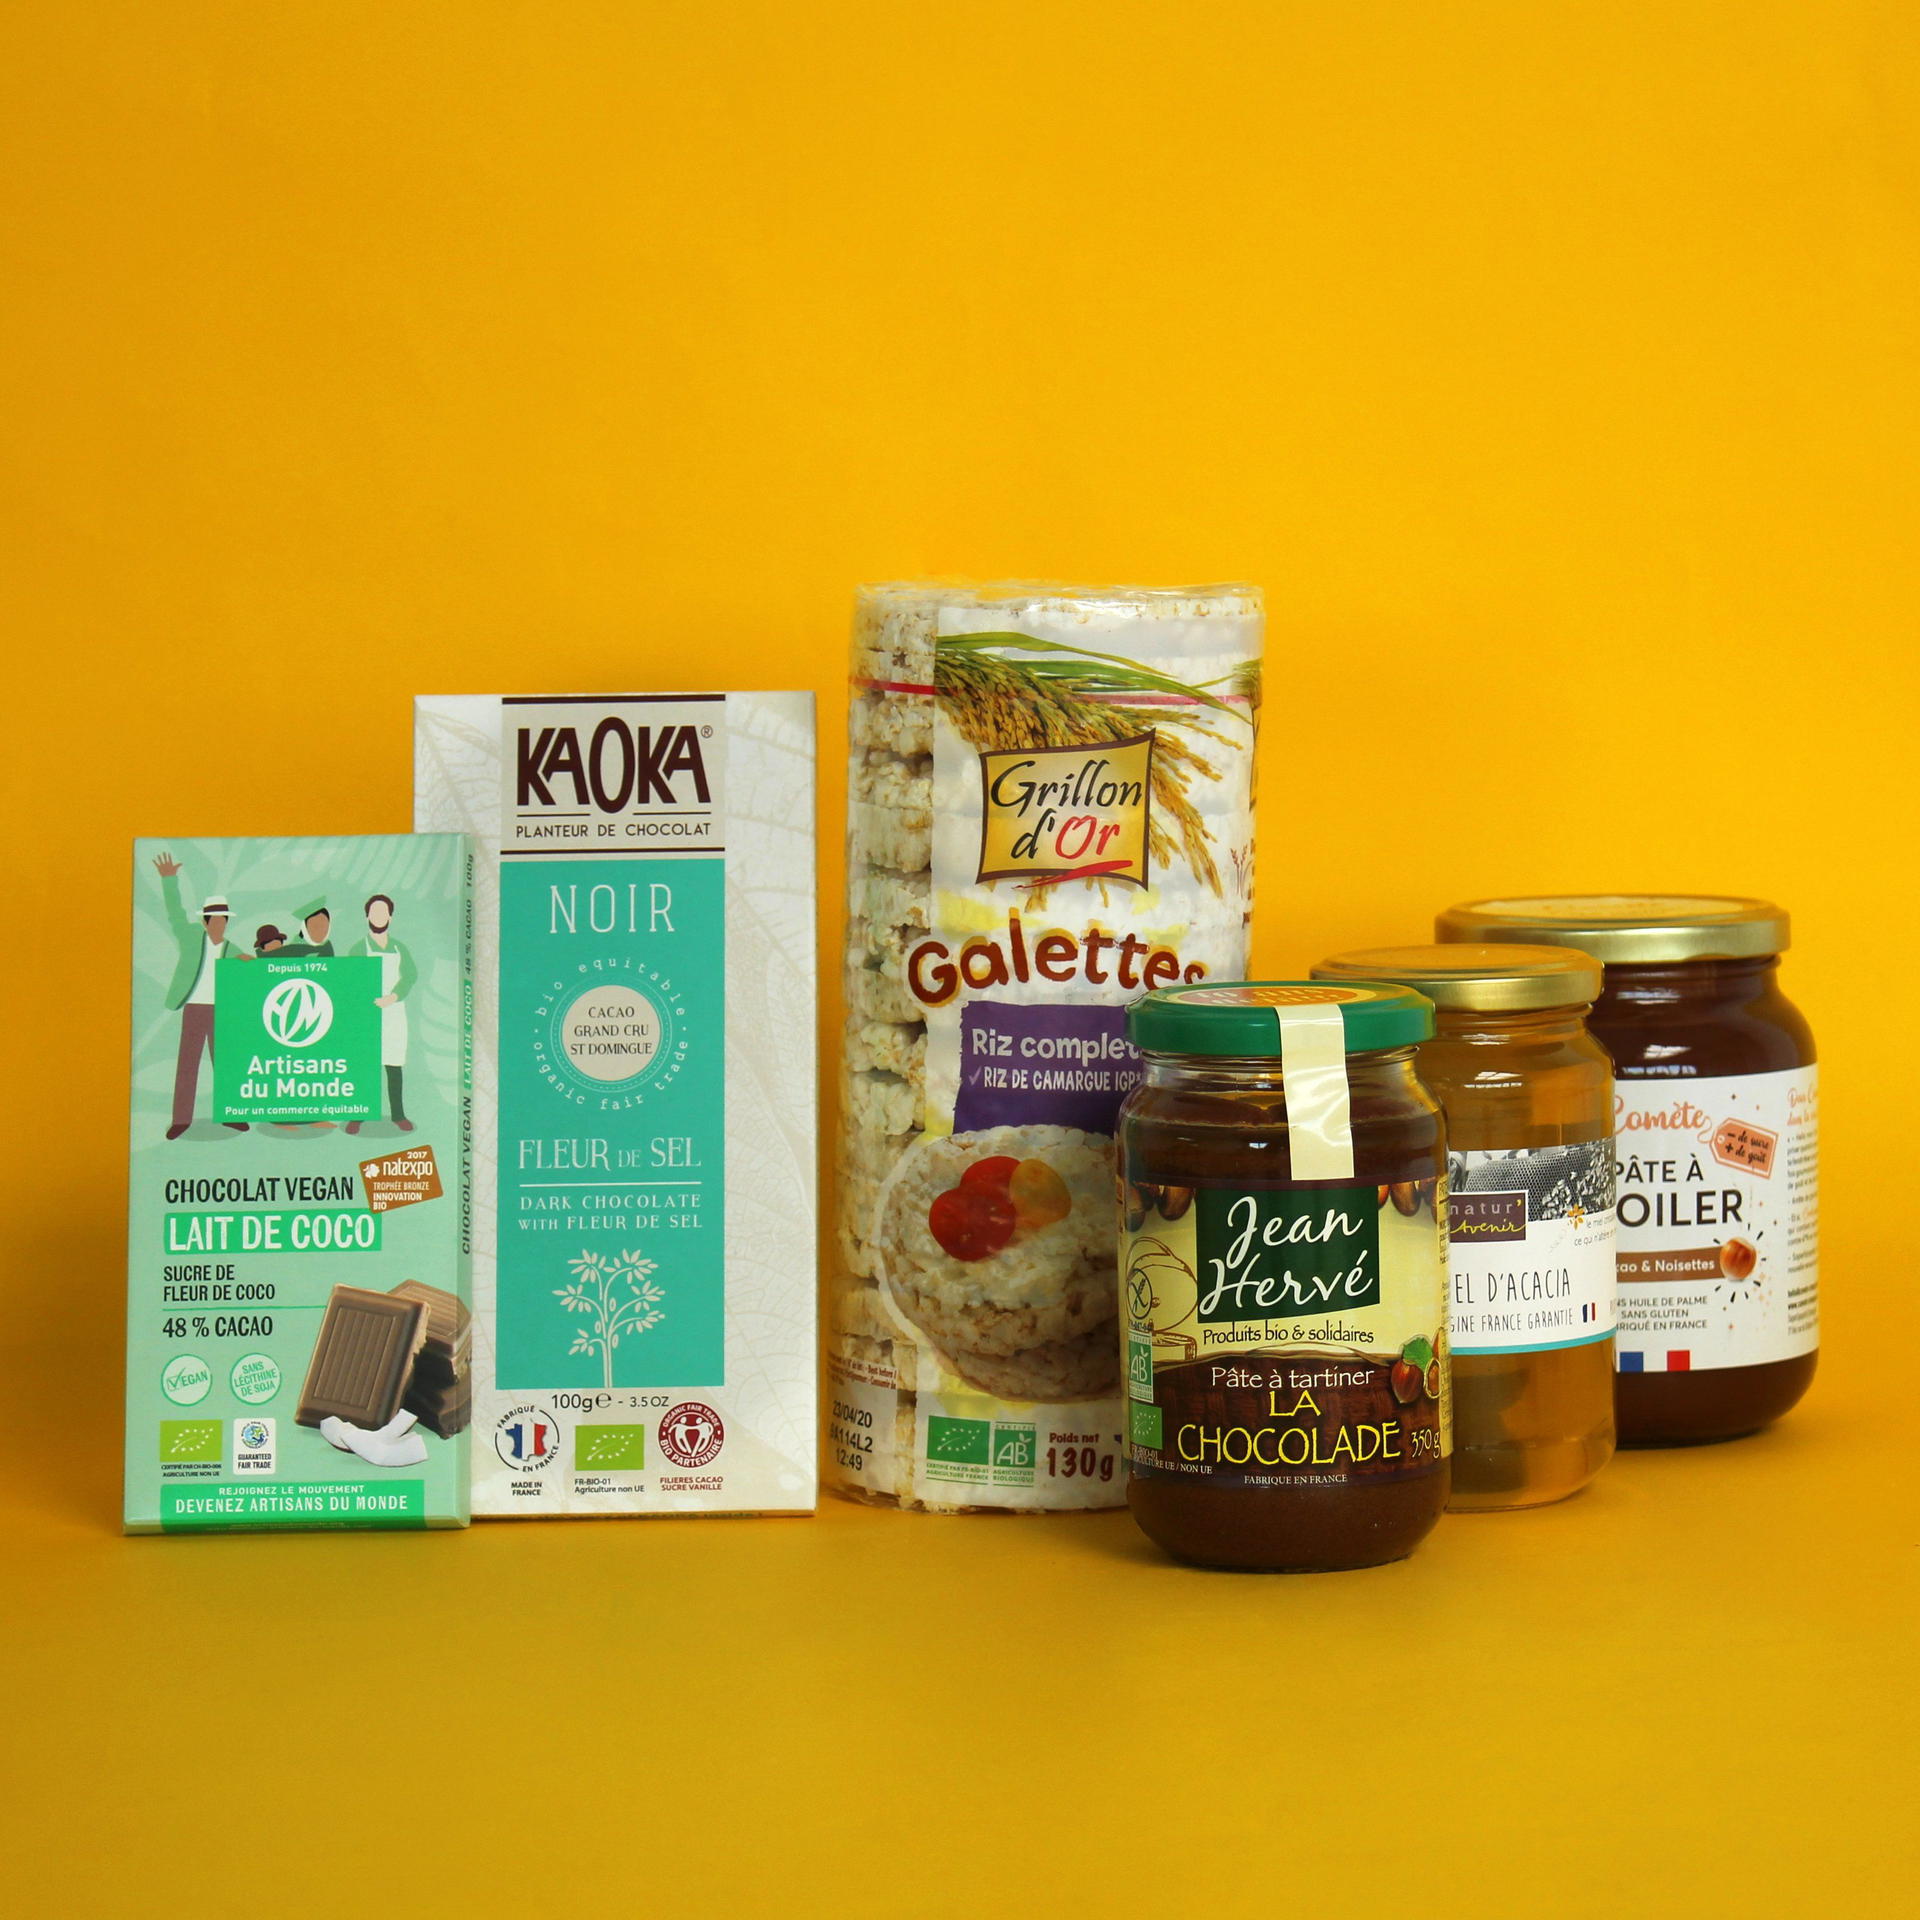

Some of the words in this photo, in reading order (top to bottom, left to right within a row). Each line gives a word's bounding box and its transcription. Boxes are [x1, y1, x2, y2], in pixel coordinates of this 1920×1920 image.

[517, 717, 711, 814] KAOKA
[990, 760, 1143, 817] Grillon
[516, 824, 588, 838] PLANTEUR
[598, 824, 616, 837] DE
[625, 822, 711, 836] CHOCOLAT
[1012, 811, 1120, 860] d'Or
[466, 854, 474, 887] 100g
[550, 884, 675, 934] NOIR
[908, 910, 1206, 1003] Galettes
[268, 964, 301, 974] Depuis
[305, 963, 328, 972] 1974
[536, 982, 562, 1016] bio
[578, 958, 685, 1016] equitable
[588, 1006, 634, 1018] CACAO
[574, 1025, 619, 1037] GRAND
[624, 1025, 648, 1037] CRU
[570, 1044, 585, 1055] ST
[588, 1042, 652, 1055] DOMINGUE
[972, 1029, 1012, 1058] Riz
[248, 1056, 348, 1076] Artisans
[534, 1042, 586, 1104] organic
[600, 1094, 643, 1110] fair
[654, 1041, 688, 1090] trade
[240, 1080, 268, 1099] du
[276, 1077, 355, 1098] Monde
[984, 1067, 1007, 1088] RIZ
[1012, 1068, 1028, 1088] DE
[1032, 1070, 1110, 1091] CAMARGUE
[225, 1106, 248, 1116] Pour
[267, 1106, 319, 1115] commerce
[322, 1104, 369, 1116] équitable
[463, 1096, 472, 1154] VEGAN
[1738, 1130, 1748, 1143] de
[1750, 1138, 1768, 1149] sucre
[518, 1138, 612, 1171] FLEUR
[618, 1150, 640, 1167] DE
[650, 1137, 701, 1167] SEL
[1736, 1145, 1745, 1157] de
[383, 1158, 432, 1179] natexpo
[1686, 1153, 1704, 1181] À
[166, 1178, 280, 1204] CHOCOLAT
[284, 1176, 354, 1201] VEGAN
[373, 1181, 401, 1190] TROPHÉE
[404, 1182, 430, 1190] BRONZE
[373, 1192, 422, 1200] INNOVATION
[373, 1202, 387, 1210] BIO
[462, 1158, 472, 1254] CHOCOLAT
[520, 1197, 572, 1210] DARK
[582, 1194, 701, 1209] CHOCOLATE
[1616, 1189, 1742, 1227] OILER
[169, 1216, 234, 1250] LAIT
[242, 1216, 282, 1249] DE
[291, 1214, 375, 1248] COCO
[518, 1218, 558, 1231] WITH
[567, 1217, 627, 1230] FLEUR
[636, 1216, 660, 1228] DE
[670, 1215, 702, 1228] SEL
[1226, 1196, 1363, 1269] Jean
[164, 1266, 212, 1282] SUCRE
[216, 1264, 235, 1281] DE
[1641, 1260, 1650, 1272] &
[1655, 1259, 1715, 1272] Noisettes
[1200, 1250, 1374, 1314] Hervé
[1488, 1268, 1570, 1301] D'ACACIA
[163, 1286, 208, 1302] FLEUR
[213, 1285, 232, 1300] DE
[237, 1284, 275, 1300] COCO
[1630, 1298, 1658, 1306] HUILE
[1661, 1298, 1672, 1306] DE
[1677, 1296, 1707, 1305] PALME
[1482, 1310, 1522, 1332] FRANCE
[1528, 1308, 1573, 1330] GARANTIE
[1621, 1310, 1647, 1319] SANS
[1650, 1309, 1688, 1318] GLUTEN
[163, 1318, 187, 1337] 48
[192, 1318, 210, 1336] %
[215, 1316, 273, 1336] CACAO
[1203, 1322, 1261, 1345] Produits
[1265, 1320, 1288, 1340] bio
[1292, 1327, 1304, 1340] &
[1308, 1320, 1374, 1343] solidaires
[1654, 1322, 1666, 1330] EN
[1670, 1320, 1707, 1329] FRANCE
[234, 1368, 277, 1388] LÉCITHINE
[242, 1361, 264, 1374] SANS
[1130, 1356, 1148, 1382] AB
[1212, 1366, 1263, 1388] Pâte
[1269, 1369, 1283, 1388] à
[1288, 1366, 1375, 1388] tartiner
[241, 1386, 252, 1396] DE
[254, 1380, 276, 1393] SOJA
[630, 1397, 648, 1407] 3.5
[650, 1396, 669, 1407] OZ
[1268, 1390, 1321, 1417] LA
[662, 1405, 686, 1428] ORGANIC
[687, 1404, 702, 1412] FAIR
[703, 1407, 720, 1427] TRADE
[833, 1400, 872, 1428] 23/04/20
[1049, 1433, 1078, 1443] Poids
[1082, 1433, 1099, 1443] net
[1178, 1421, 1400, 1465] CHOCOLADE
[535, 1445, 559, 1470] FRANCE
[661, 1439, 672, 1454] BIO
[672, 1439, 722, 1466] PARTENAIRE
[836, 1448, 862, 1471] 12:49
[997, 1442, 1029, 1466] AB
[926, 1470, 964, 1478] AGRICULTURE
[1165, 1462, 1175, 1470] UE
[1180, 1463, 1198, 1474] NON
[1200, 1465, 1212, 1474] UE
[219, 1487, 277, 1495] REJOIGNEZ
[282, 1486, 294, 1494] LE
[299, 1485, 364, 1494] MOUVEMENT
[575, 1486, 616, 1494] Agriculture
[1244, 1474, 1291, 1485] FABRIQUE
[1294, 1474, 1308, 1484] EN
[1309, 1474, 1348, 1484] FRANCE
[176, 1499, 244, 1513] DEVENEZ
[250, 1497, 323, 1512] ARTISANS
[330, 1497, 349, 1510] DU
[356, 1496, 408, 1510] MONDE
